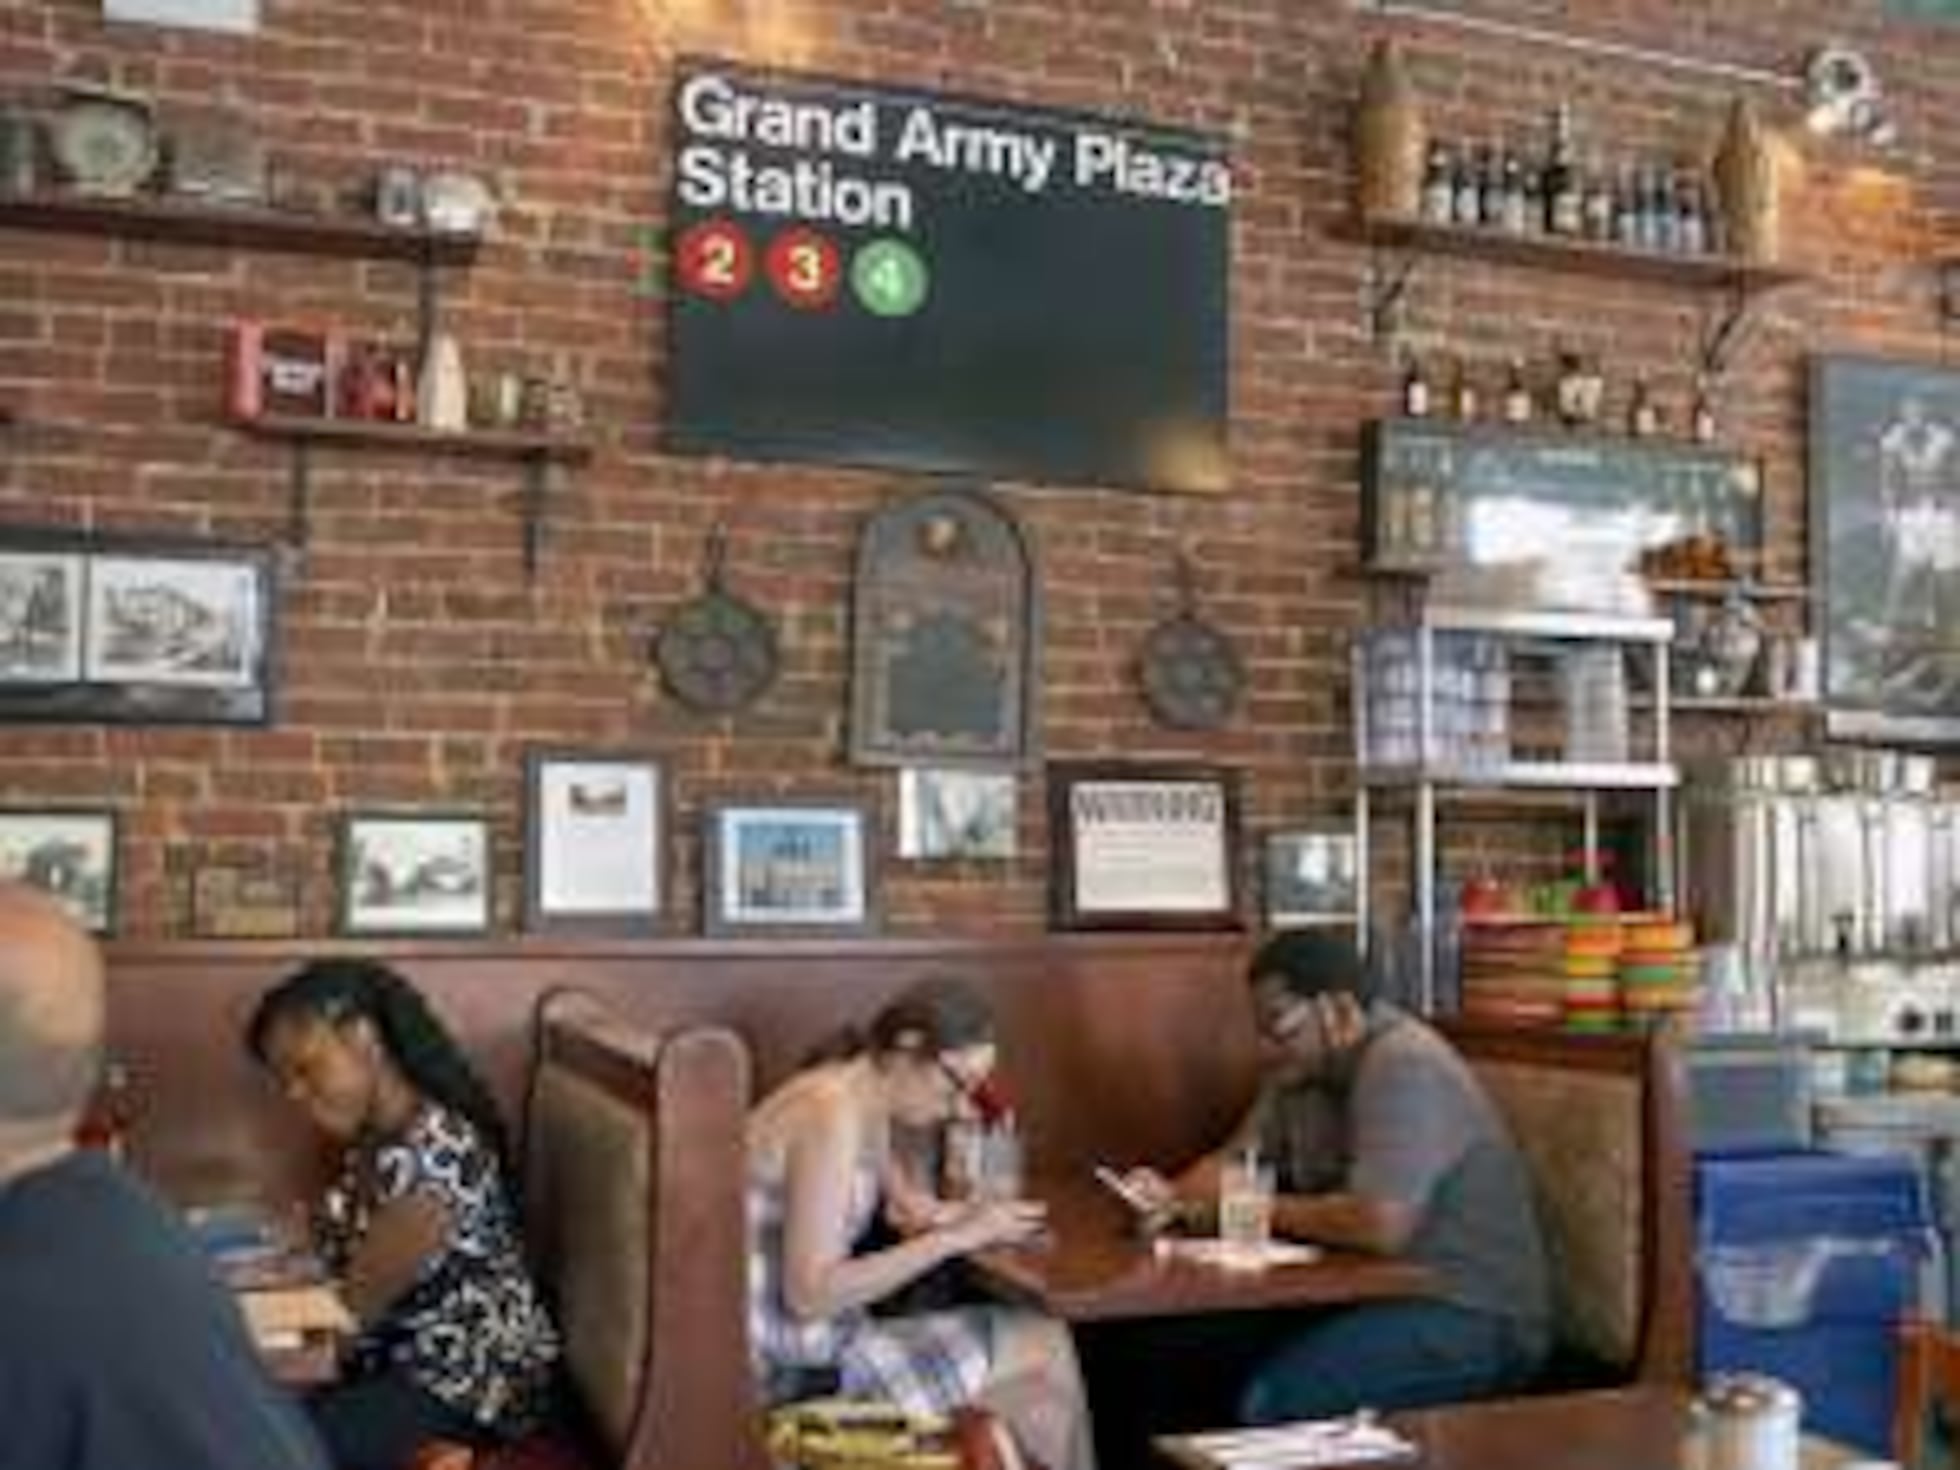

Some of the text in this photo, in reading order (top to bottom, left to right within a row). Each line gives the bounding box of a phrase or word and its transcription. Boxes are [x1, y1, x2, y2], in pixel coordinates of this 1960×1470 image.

[681, 75, 1233, 206] Grand Army Plaza
[677, 147, 912, 228] Station
[703, 234, 901, 303] 2 3 4
